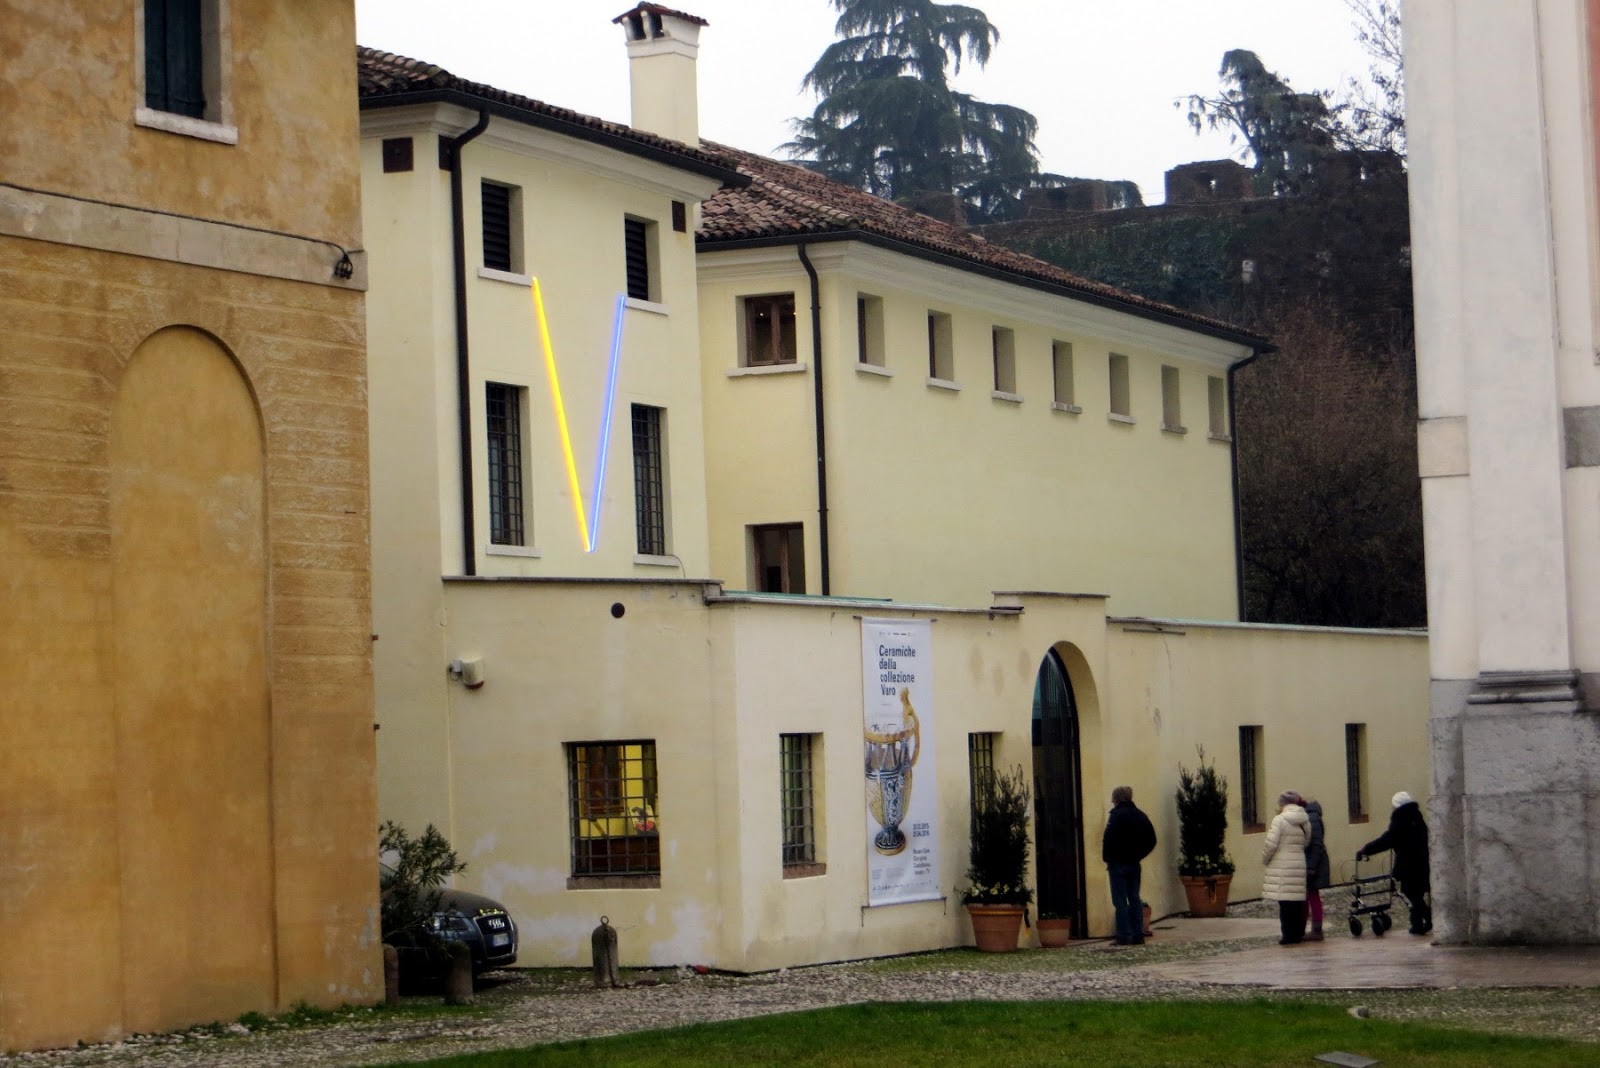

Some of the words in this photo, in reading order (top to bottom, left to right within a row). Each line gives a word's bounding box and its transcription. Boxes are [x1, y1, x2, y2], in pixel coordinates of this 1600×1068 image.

[879, 644, 916, 657] Ceramiche
[879, 658, 897, 670] della
[880, 671, 915, 683] collezione
[880, 684, 896, 696] Varo
